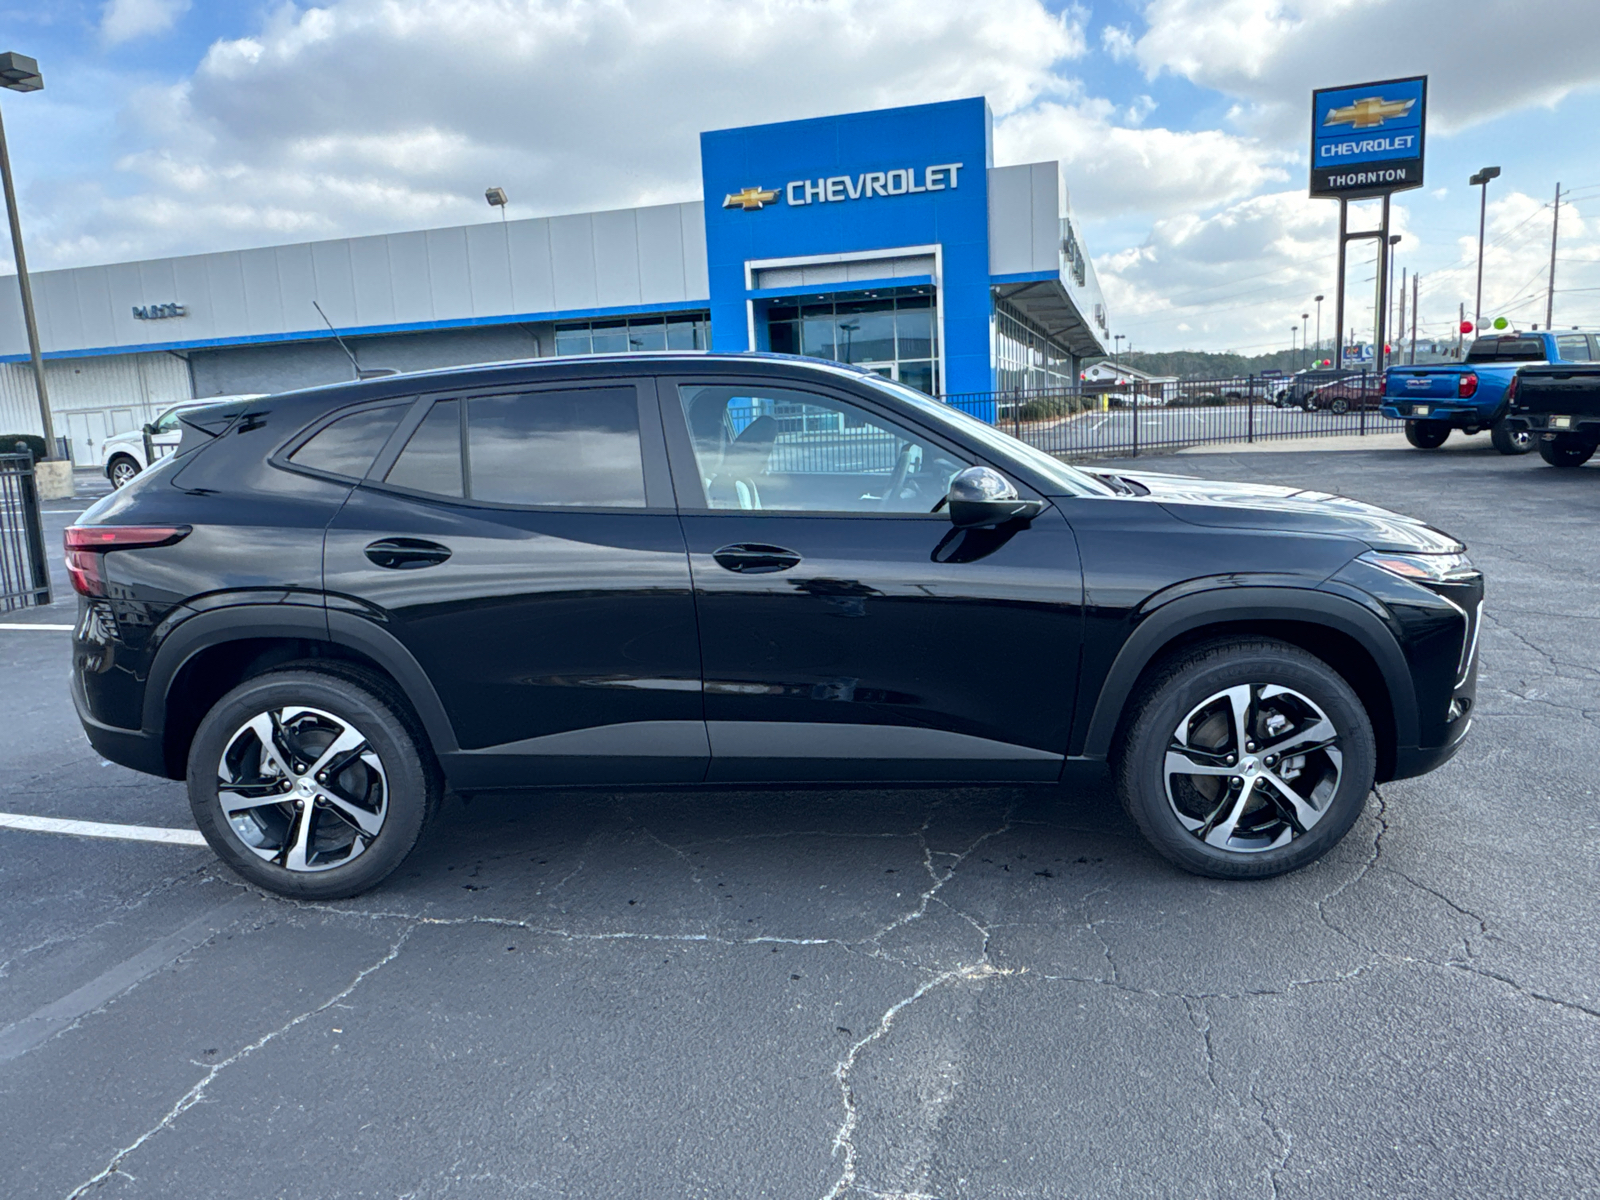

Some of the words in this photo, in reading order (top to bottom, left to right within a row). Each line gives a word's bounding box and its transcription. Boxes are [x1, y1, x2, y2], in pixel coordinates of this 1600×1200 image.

[1320, 135, 1415, 157] CHEVROLET
[786, 162, 963, 206] CHEVROLET
[1327, 168, 1406, 187] THORNTON
